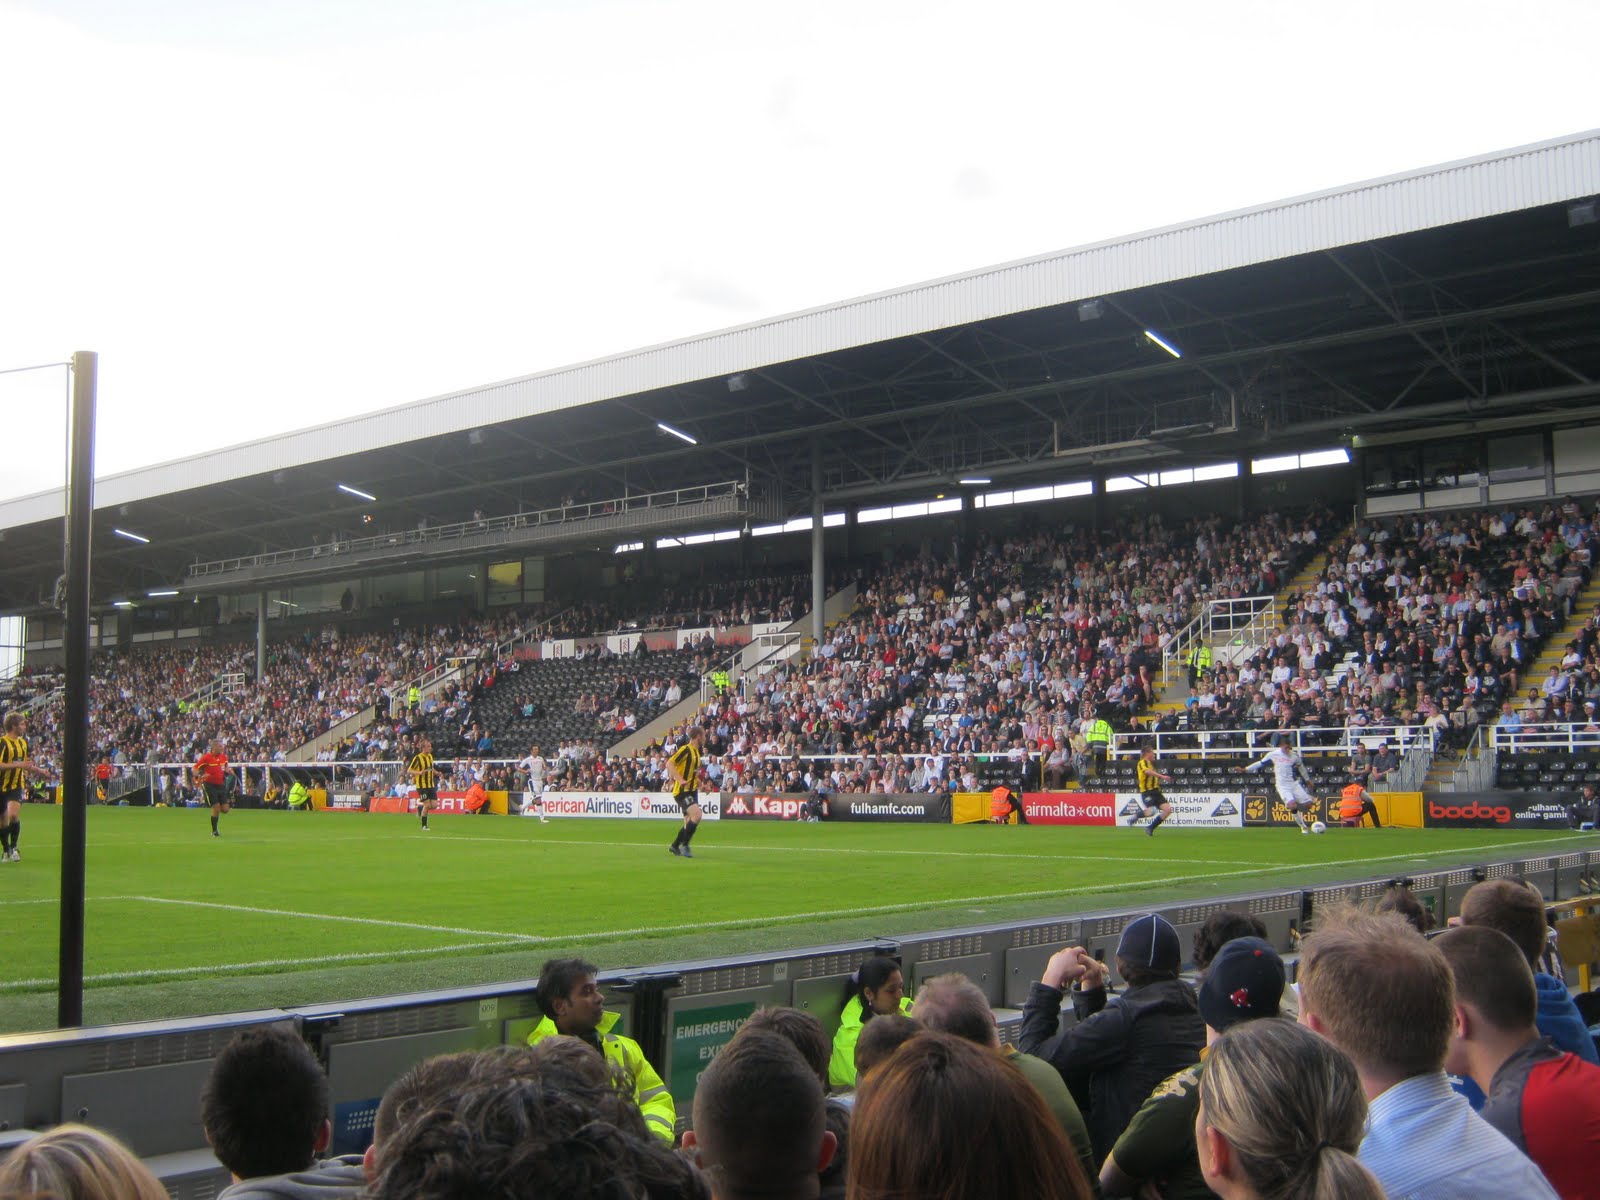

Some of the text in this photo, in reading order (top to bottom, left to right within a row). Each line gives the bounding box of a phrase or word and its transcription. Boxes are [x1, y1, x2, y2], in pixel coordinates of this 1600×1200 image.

[416, 798, 466, 810] SAT
[1180, 796, 1211, 804] FULHAM
[651, 801, 719, 814] maxicle
[850, 802, 925, 815] fulhamfc.com
[1159, 806, 1203, 814] BERSHIP
[1271, 801, 1293, 812] Jac
[1429, 801, 1511, 823] bodog
[1271, 811, 1318, 822] Wolkin
[1542, 811, 1568, 820] gami
[1127, 818, 1230, 826] www.fulmfc.com/members
[676, 1017, 749, 1040] EMERGENC
